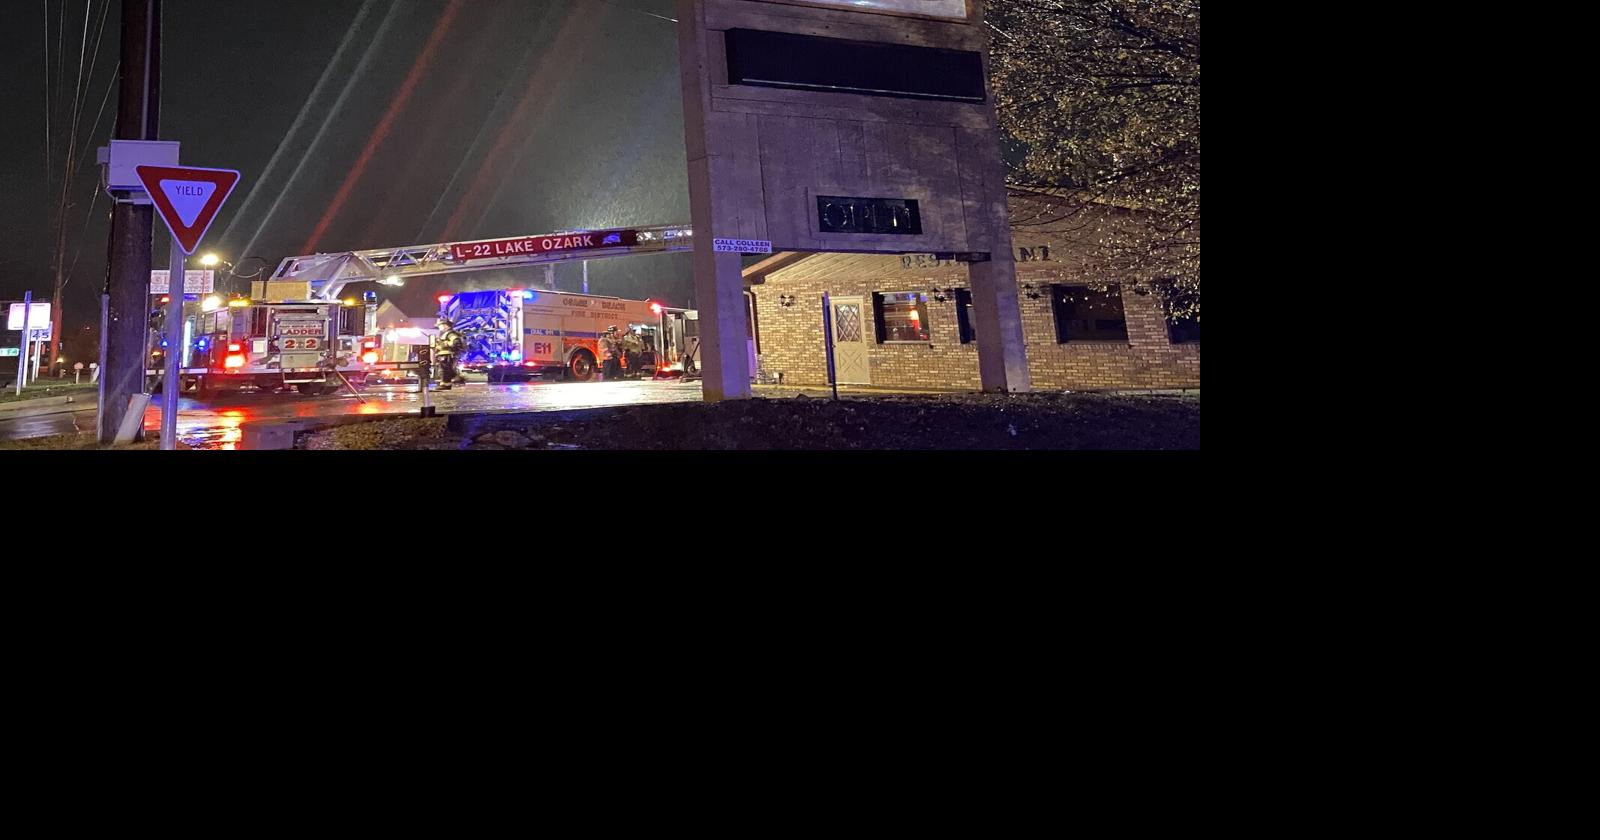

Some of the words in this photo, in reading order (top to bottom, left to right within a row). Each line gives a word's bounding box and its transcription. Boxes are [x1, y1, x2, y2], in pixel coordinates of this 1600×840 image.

[176, 186, 203, 196] YIELD
[456, 244, 492, 258] L-22
[495, 241, 534, 255] LAKE
[541, 235, 594, 250] OZARK
[534, 342, 552, 354] E11
